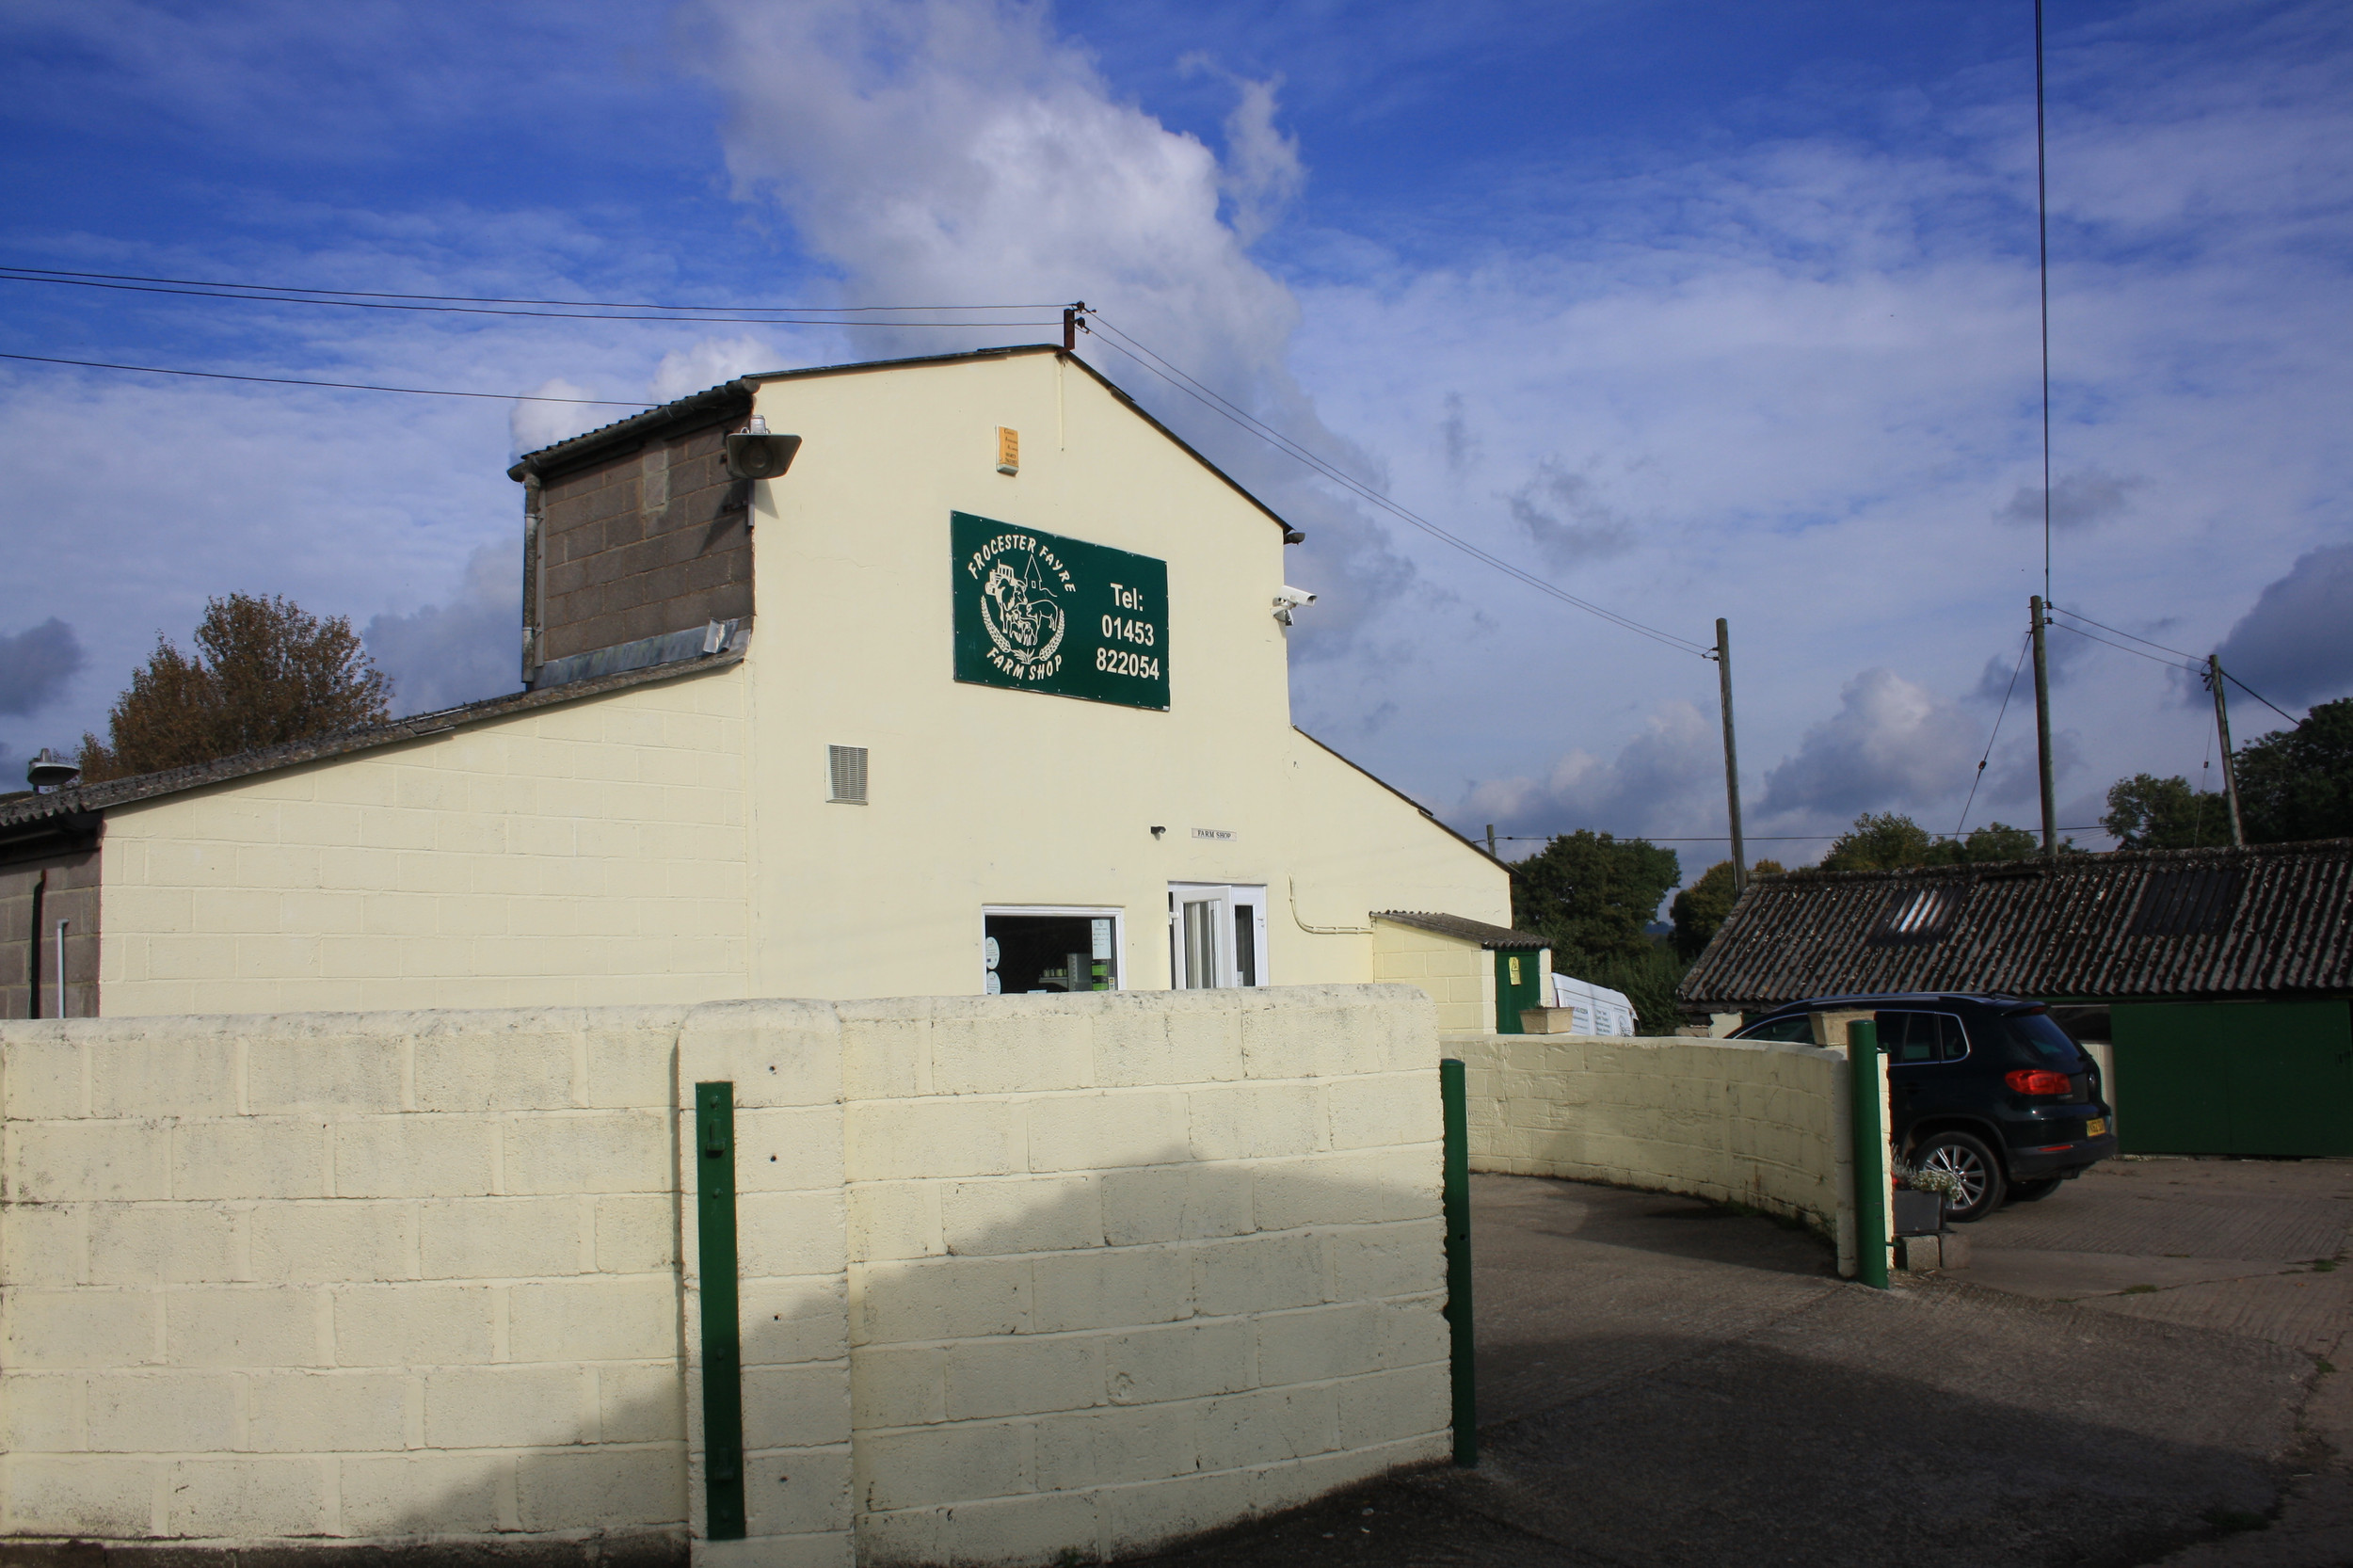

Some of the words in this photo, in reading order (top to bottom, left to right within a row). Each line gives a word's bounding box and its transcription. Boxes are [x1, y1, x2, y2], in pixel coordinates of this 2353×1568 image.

[968, 534, 1036, 580] FROCESTER
[1038, 545, 1077, 593] FAYRE
[1110, 583, 1144, 612] Tel:
[1101, 614, 1154, 647] 01453
[986, 647, 1024, 680] FARM
[1028, 654, 1063, 681] SHOP
[1096, 647, 1160, 680] 822054
[1197, 829, 1214, 838] FARM
